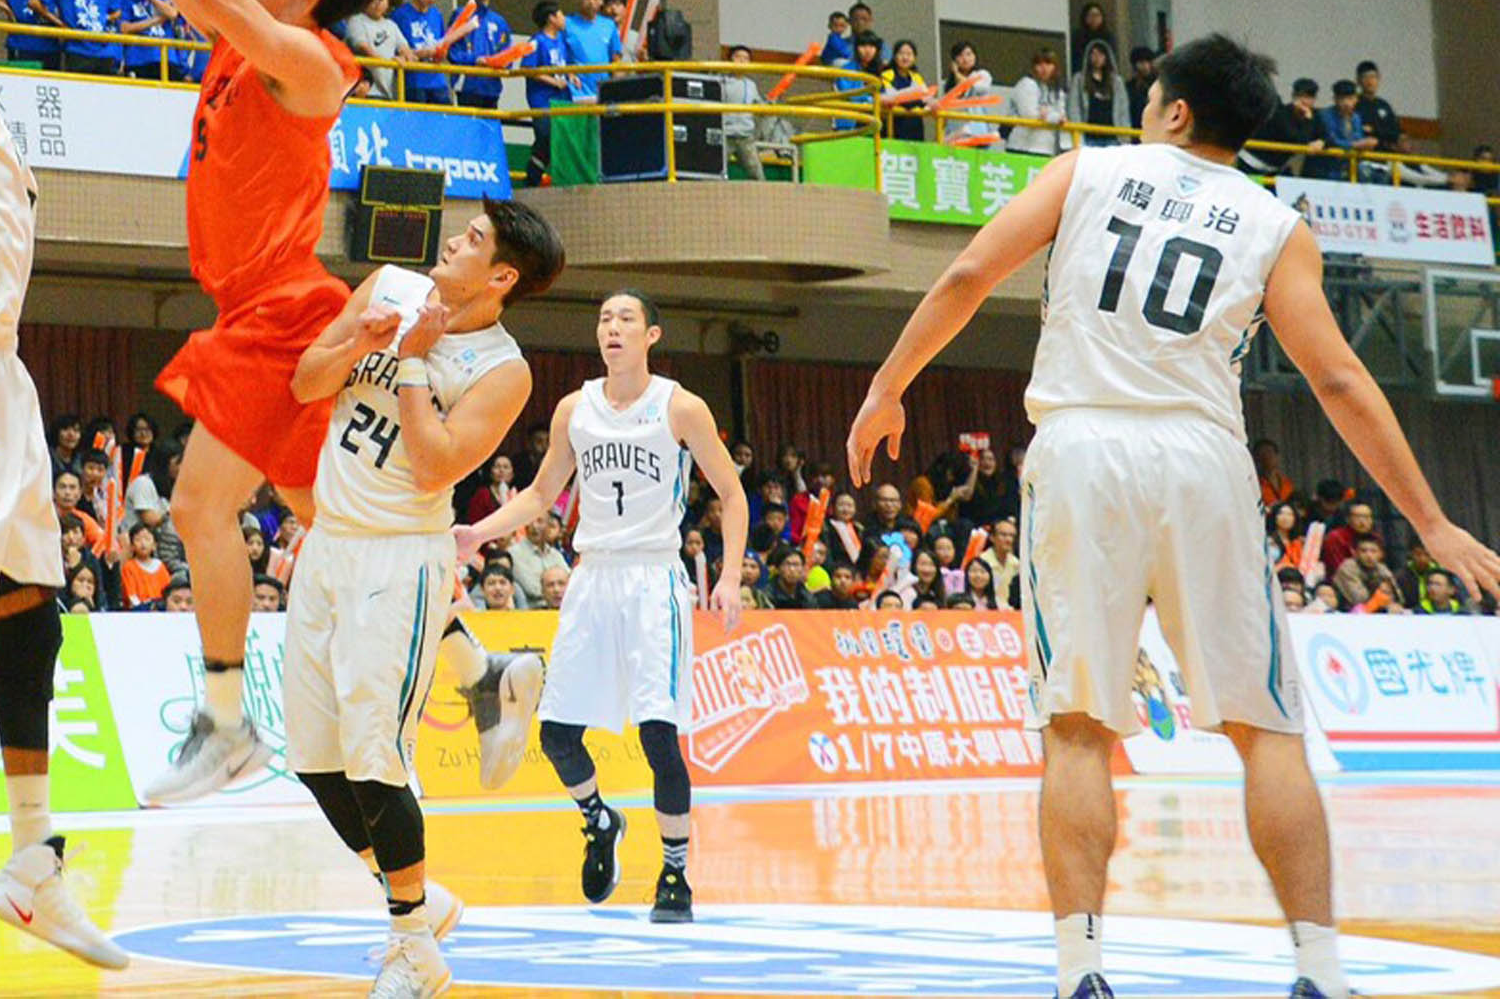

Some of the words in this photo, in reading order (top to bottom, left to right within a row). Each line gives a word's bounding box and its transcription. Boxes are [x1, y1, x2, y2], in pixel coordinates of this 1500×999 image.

[881, 149, 1040, 215] 賀寶芙
[1098, 215, 1224, 336] 10
[340, 402, 401, 469] 24
[581, 442, 661, 483] BRAVES
[612, 481, 624, 517] 1
